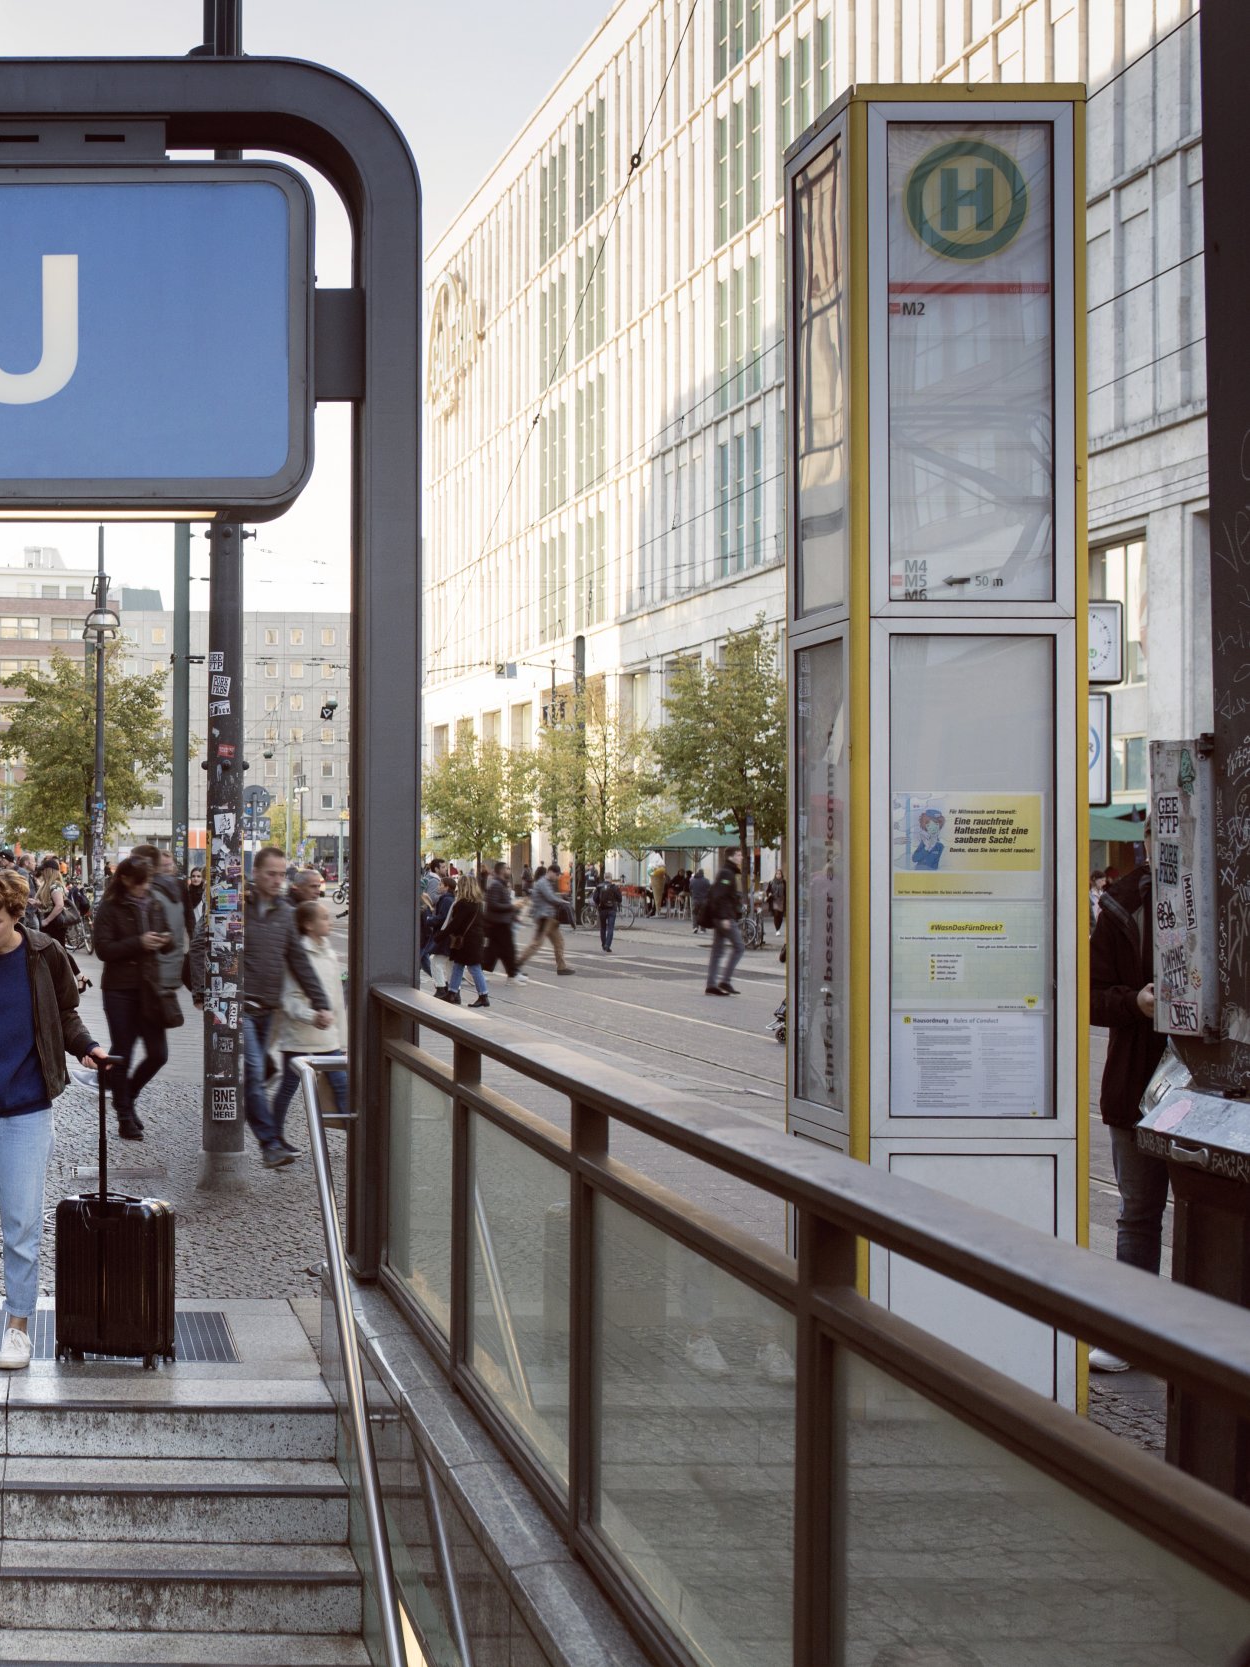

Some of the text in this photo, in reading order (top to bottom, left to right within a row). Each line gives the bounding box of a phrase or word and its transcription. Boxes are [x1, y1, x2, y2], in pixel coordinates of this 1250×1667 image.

[940, 168, 994, 231] H
[902, 302, 925, 315] M2
[904, 560, 928, 573] M4
[904, 574, 928, 587] M5
[975, 575, 1004, 586] 50 m
[904, 589, 928, 600] M6
[1158, 797, 1179, 814] GEE
[954, 817, 1014, 826] Eine rauchfreie
[1158, 815, 1179, 834] FTP
[954, 826, 1029, 835] Haltestelle ist eine
[954, 836, 1017, 844] saubere Sache!
[1183, 877, 1195, 928] MORSA
[824, 892, 834, 982] besser
[912, 1017, 949, 1025] Hausordnung
[823, 991, 835, 1094] Einfach
[213, 1089, 236, 1103] BNE
[213, 1111, 236, 1119] HERE
